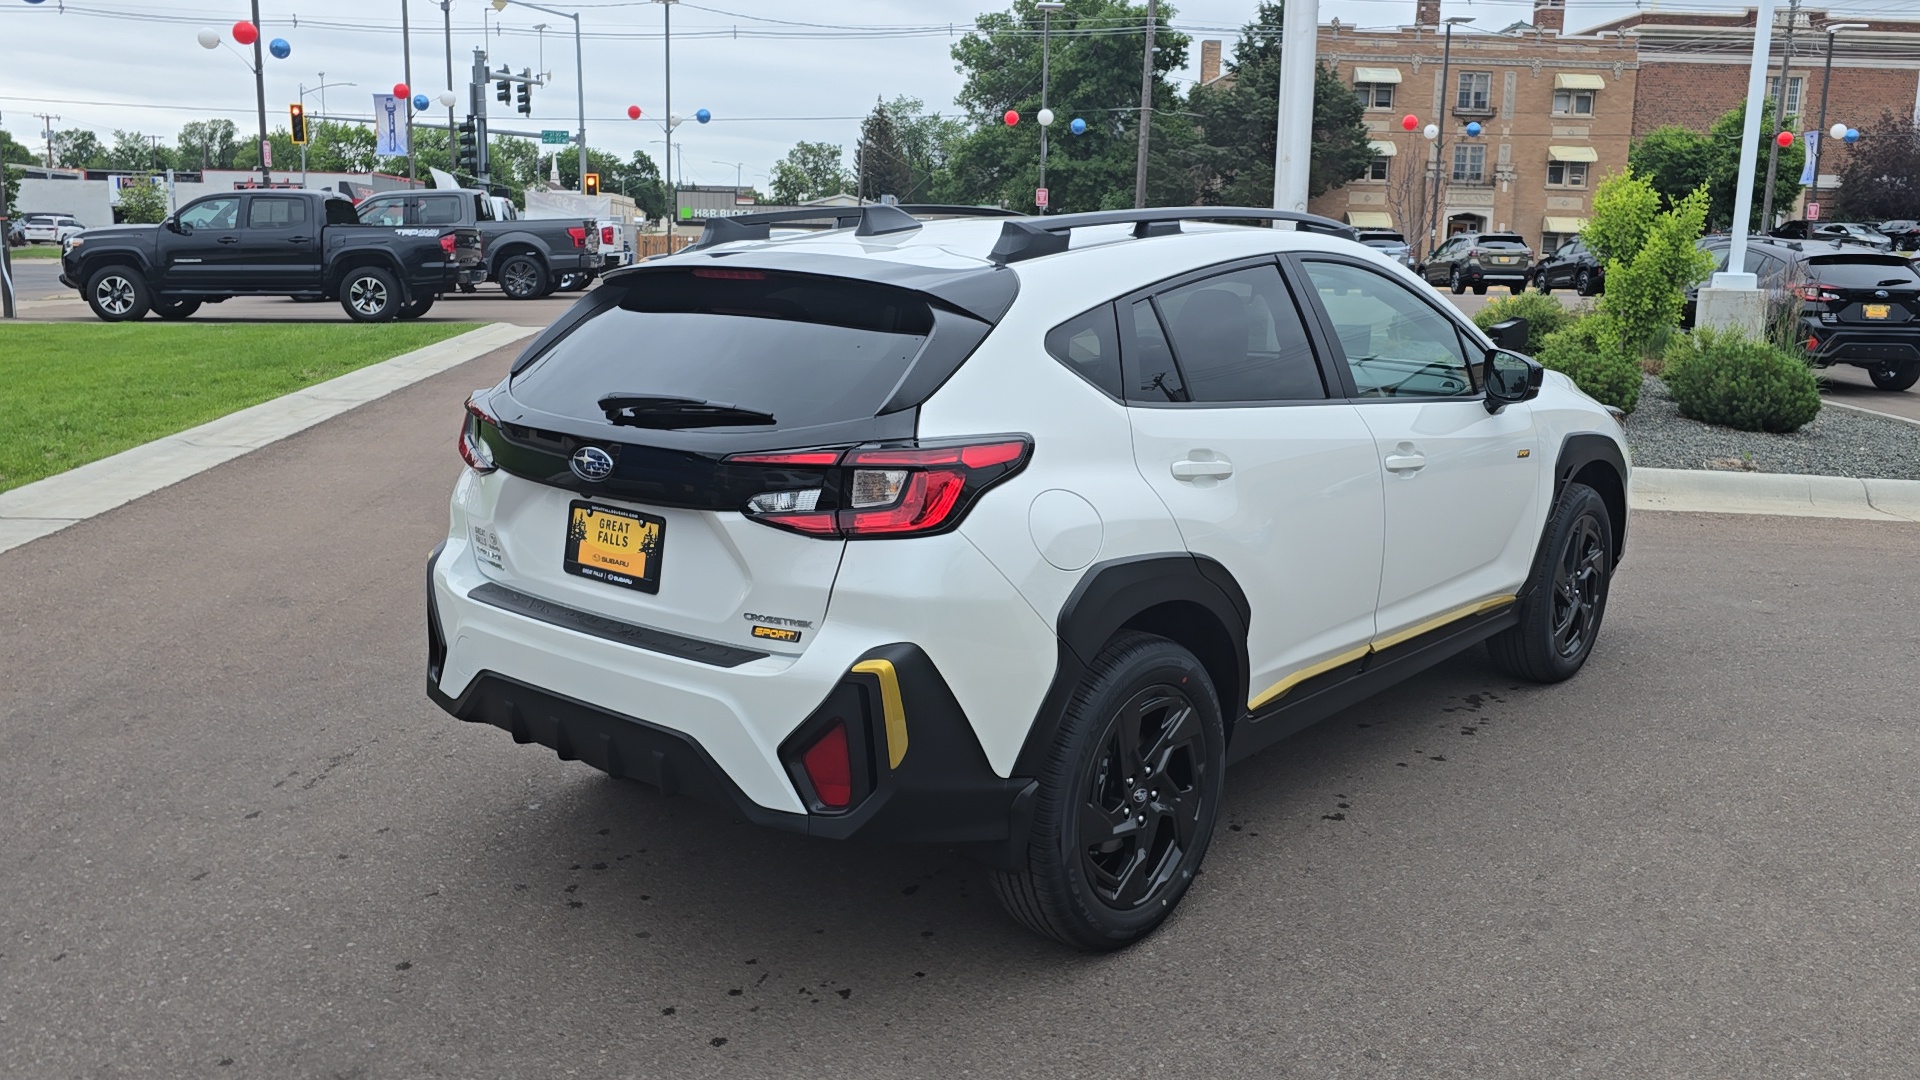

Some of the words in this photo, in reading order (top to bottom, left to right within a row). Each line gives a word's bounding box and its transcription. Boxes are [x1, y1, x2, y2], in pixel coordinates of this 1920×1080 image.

[599, 518, 631, 534] GREAT
[597, 530, 629, 547] FALLS
[601, 556, 630, 568] SUBARU
[743, 612, 814, 630] CROSSTREK
[754, 627, 795, 640] SPORT
